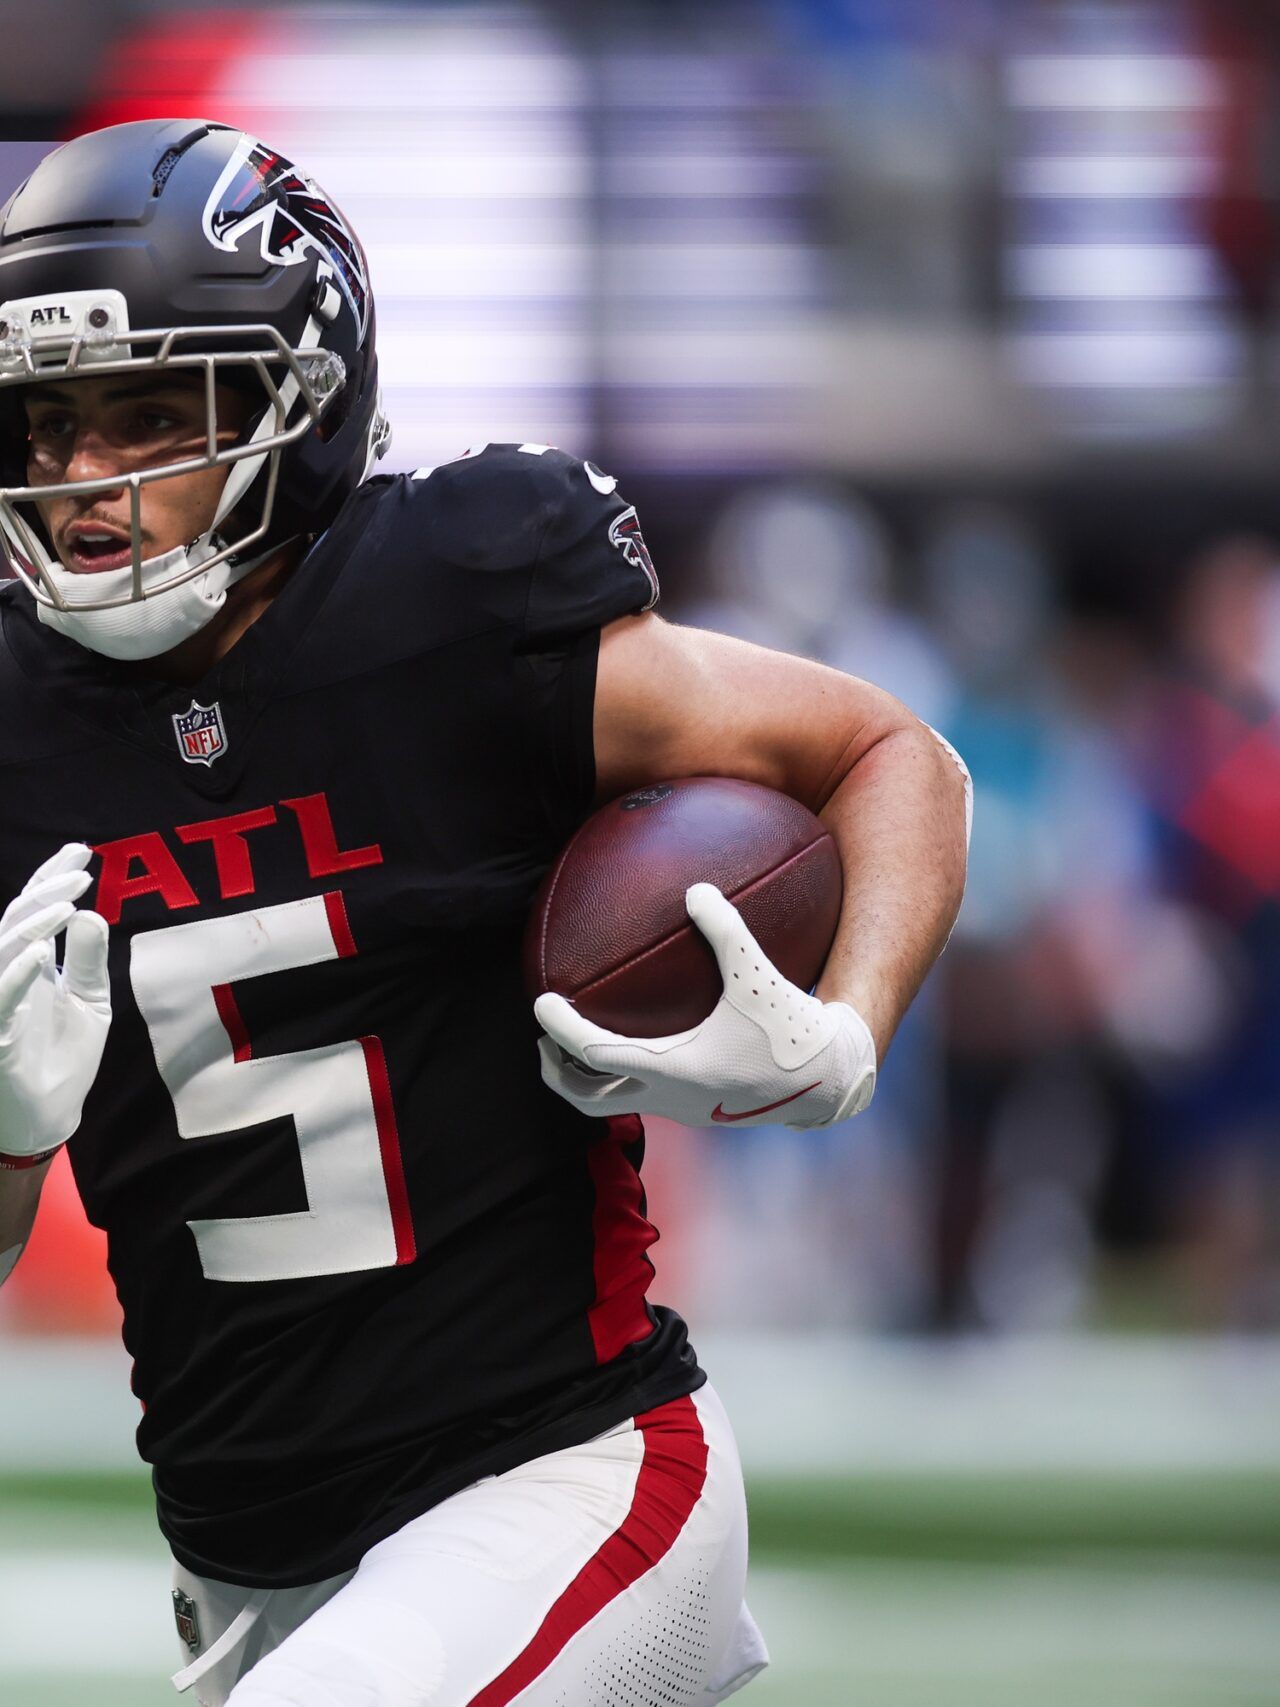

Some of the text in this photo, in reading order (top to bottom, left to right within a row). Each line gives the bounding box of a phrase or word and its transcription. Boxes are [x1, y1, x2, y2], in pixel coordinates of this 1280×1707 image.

[31, 306, 70, 323] ATL
[184, 728, 220, 755] NFL
[90, 792, 383, 925] ATL
[129, 890, 417, 1282] 5
